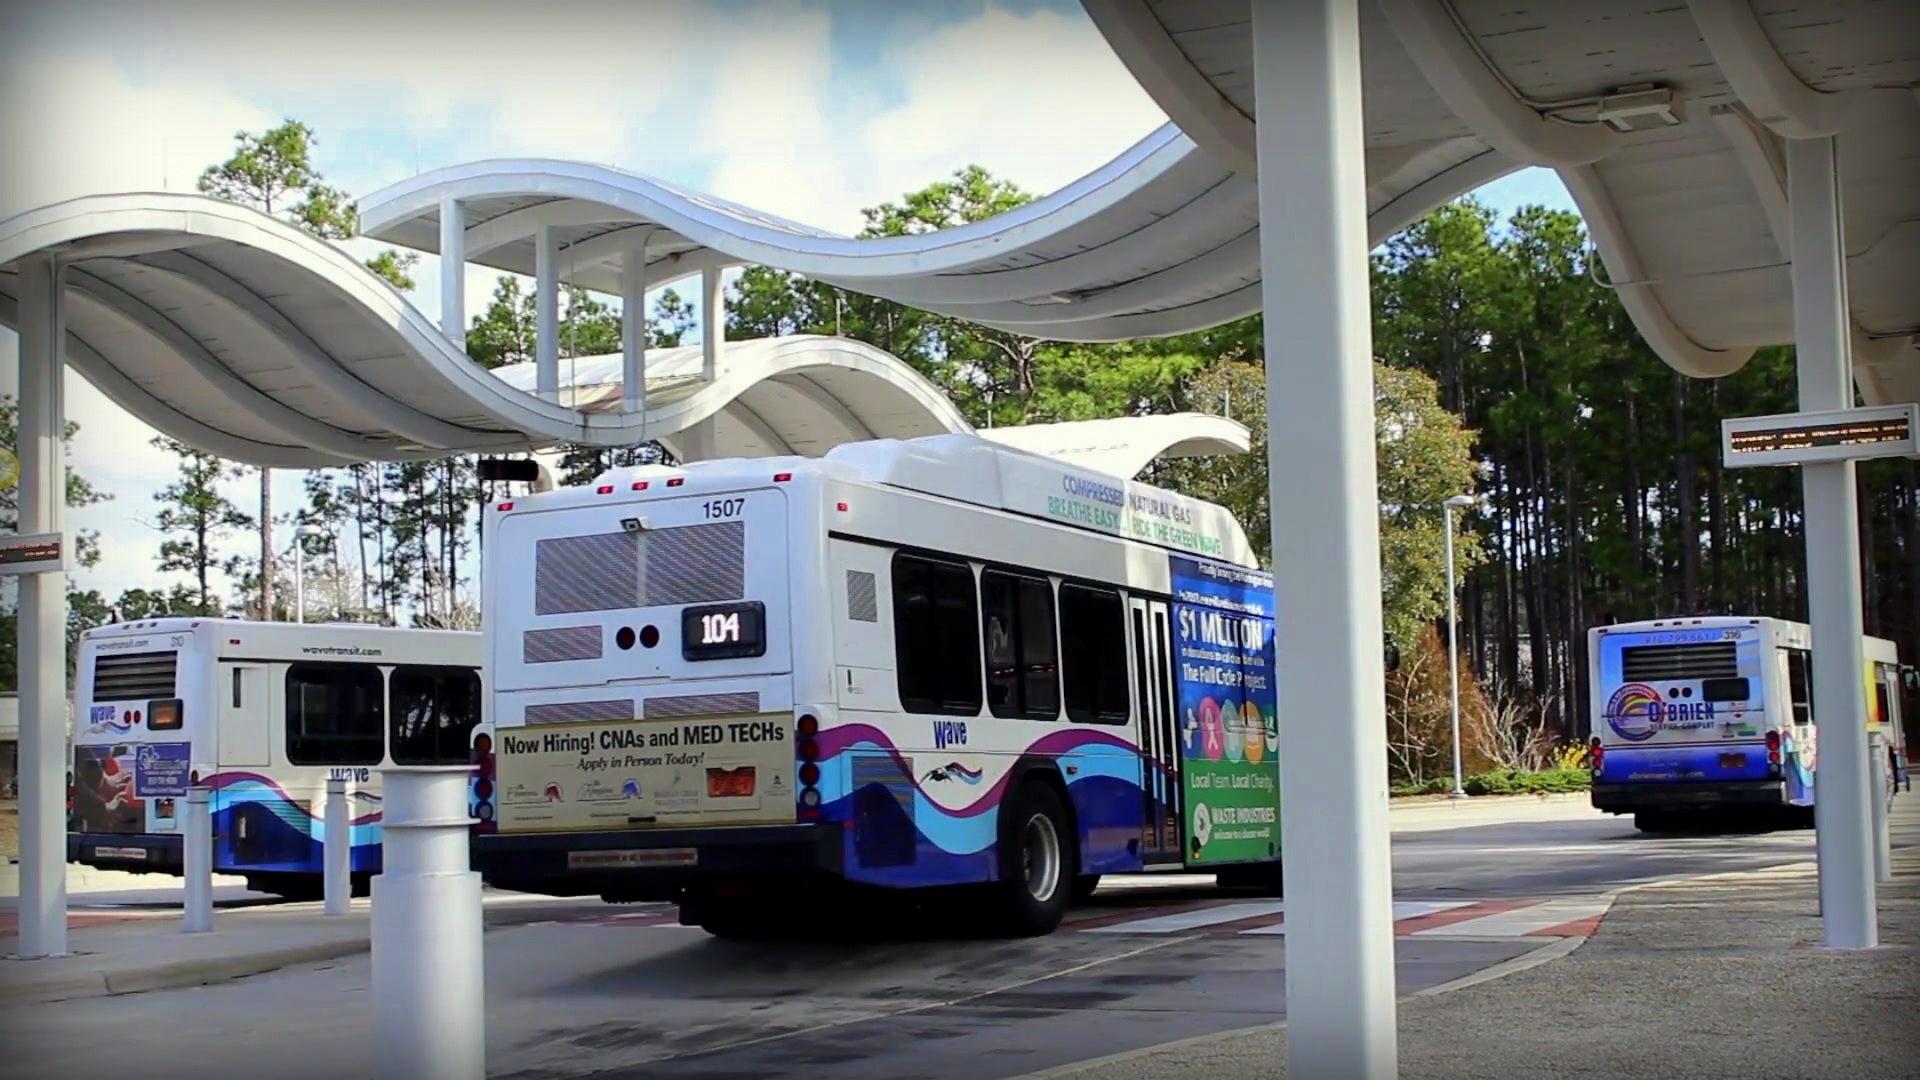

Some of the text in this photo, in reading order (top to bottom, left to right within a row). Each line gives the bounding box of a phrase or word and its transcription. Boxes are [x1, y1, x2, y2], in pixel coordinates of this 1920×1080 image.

[702, 498, 745, 519] 1507
[1047, 495, 1093, 522] BREATHE
[1063, 475, 1191, 526] COMPRESSED NATURAL GAS
[701, 613, 740, 644] 104
[1180, 607, 1197, 641] $1
[302, 646, 382, 656] wavetransit.com
[1183, 663, 1199, 682] The
[1649, 702, 1715, 722] O'BRIEN
[504, 722, 785, 755] Now Hiring! CNAs and MED TECHs
[577, 752, 704, 770] Apply in Person Today!
[1191, 772, 1210, 789] Local
[1232, 774, 1250, 789] Local
